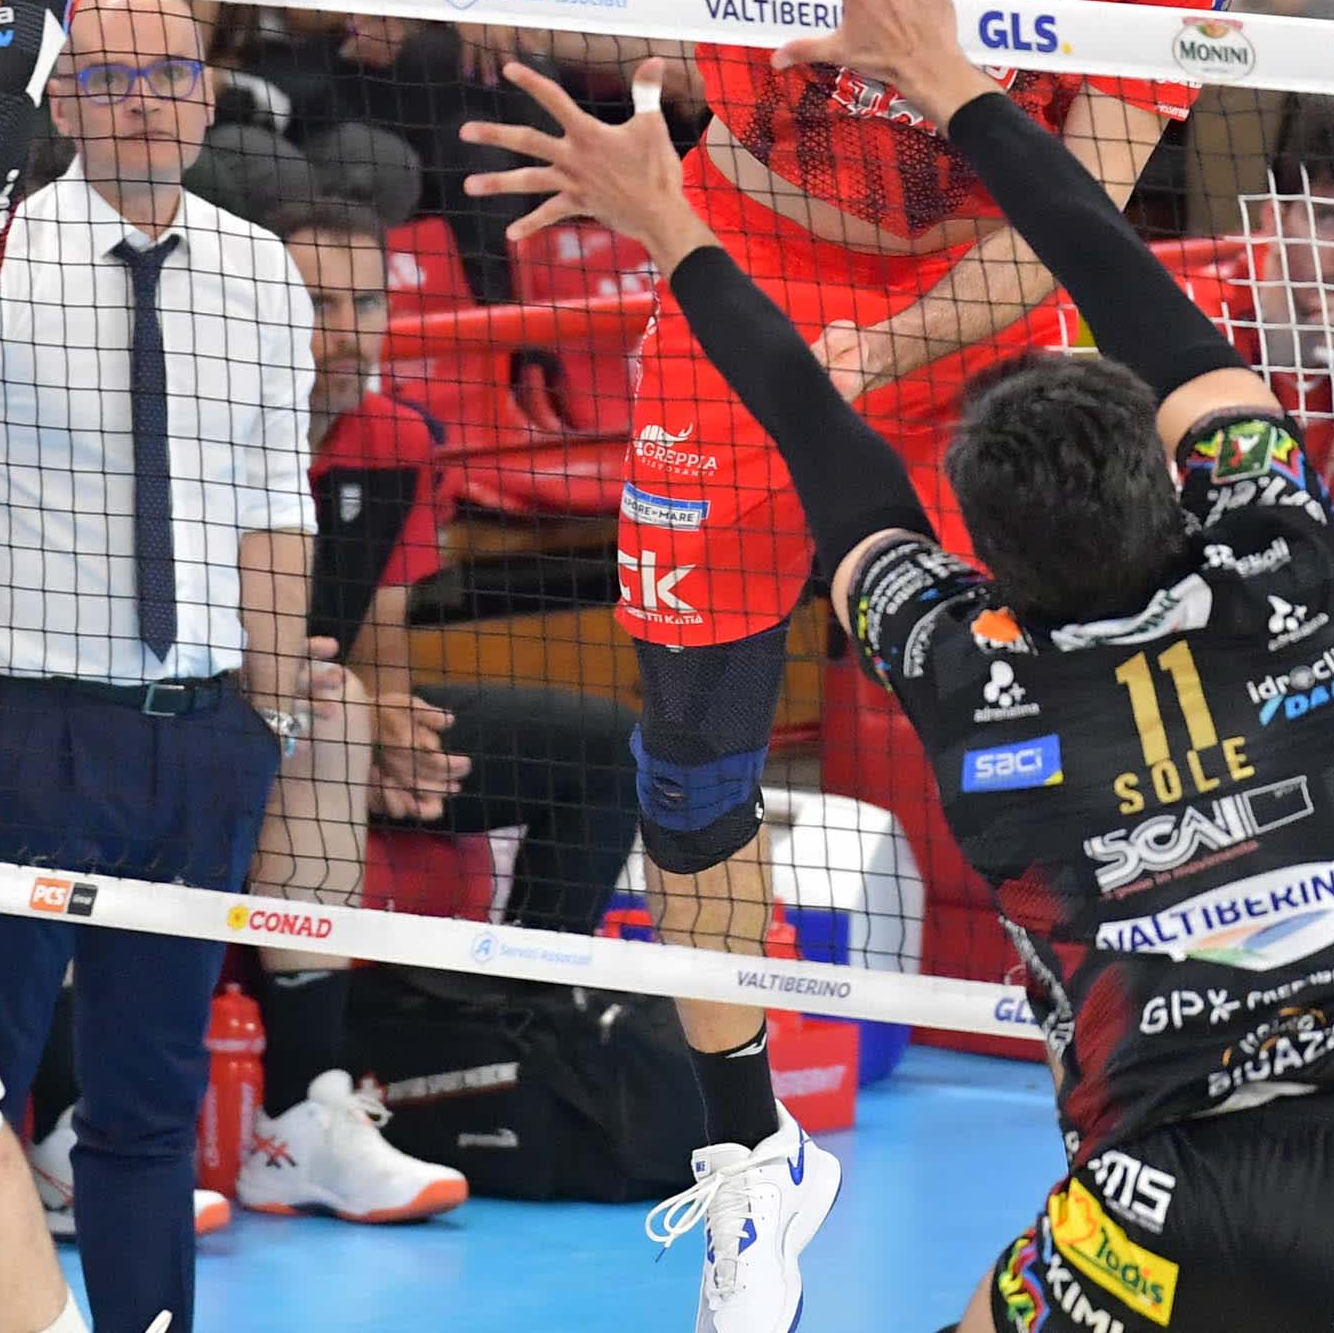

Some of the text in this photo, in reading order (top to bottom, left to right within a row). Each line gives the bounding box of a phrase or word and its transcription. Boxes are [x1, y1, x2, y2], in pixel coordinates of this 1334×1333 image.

[1179, 39, 1248, 66] MONINI
[642, 440, 719, 470] GREPPIA
[1116, 639, 1219, 767] 11
[1112, 736, 1256, 816] SOLE
[33, 885, 67, 906] PCS
[249, 910, 333, 939] CONAD
[736, 969, 852, 999] VALTIBERINO
